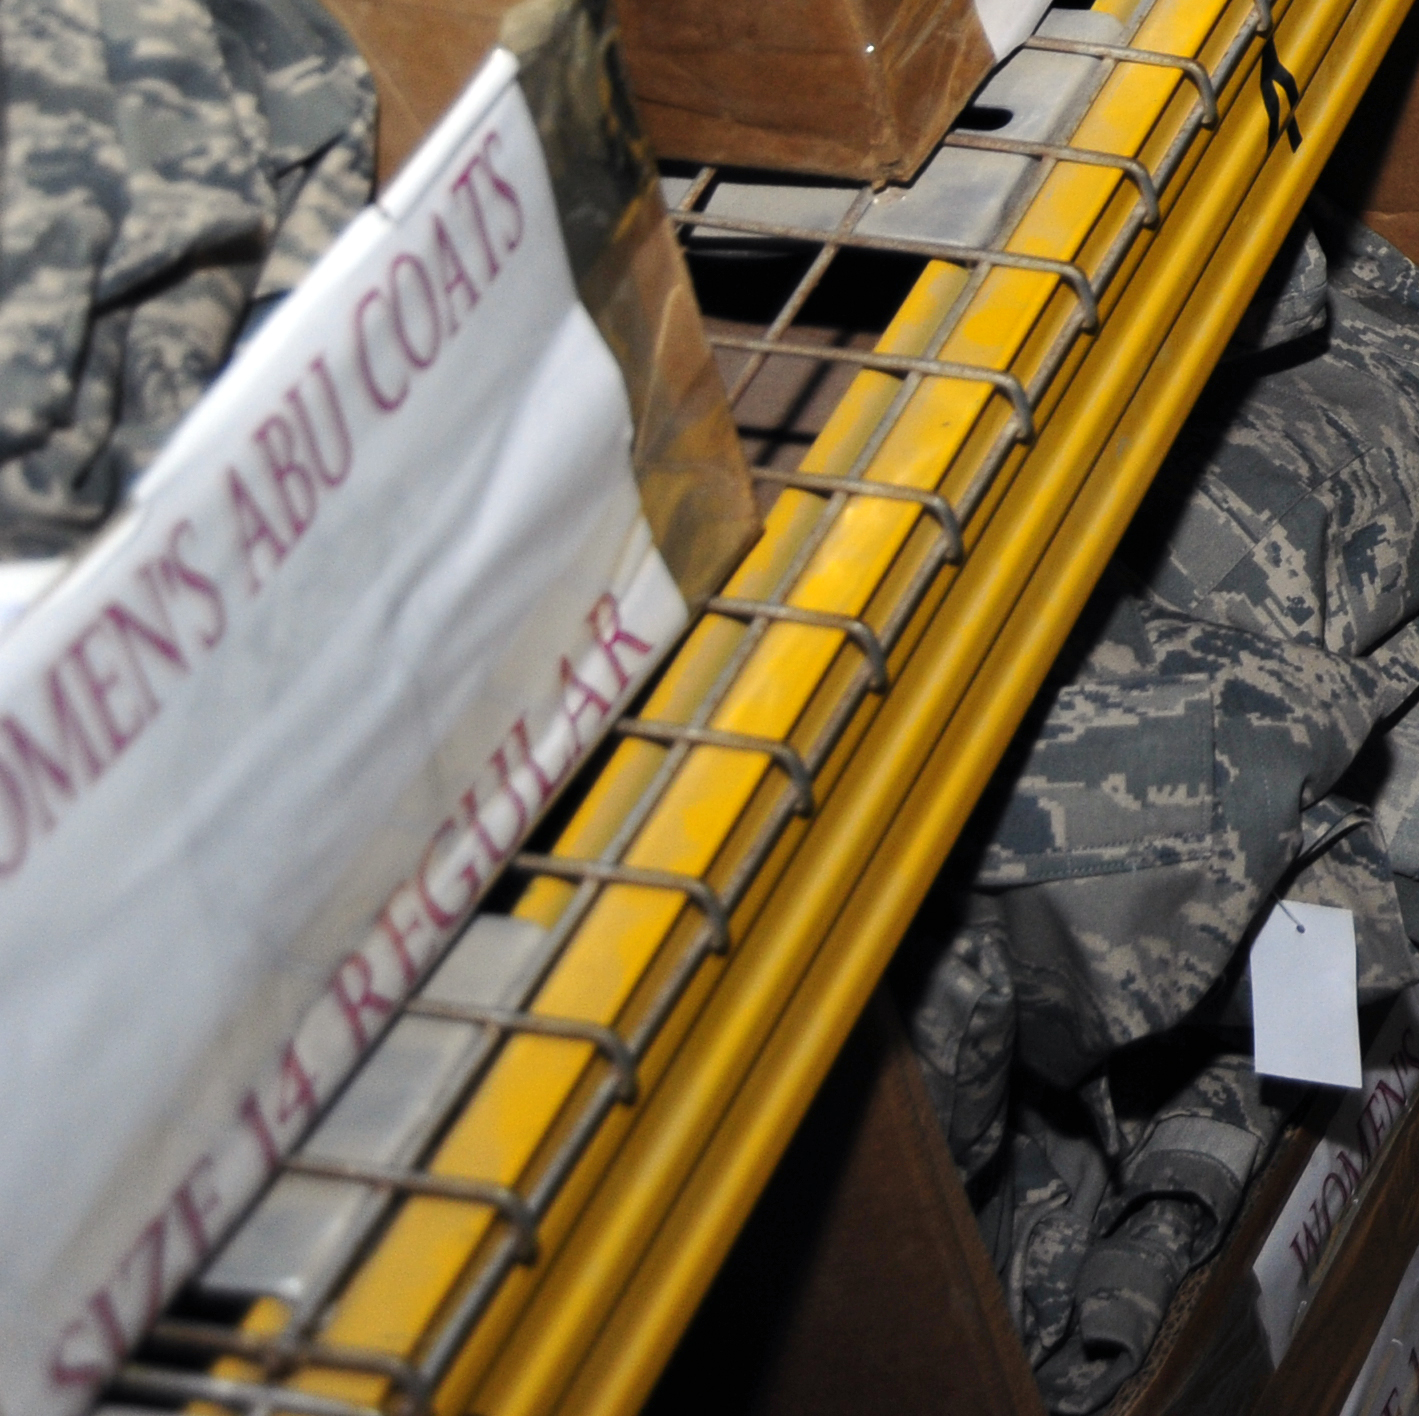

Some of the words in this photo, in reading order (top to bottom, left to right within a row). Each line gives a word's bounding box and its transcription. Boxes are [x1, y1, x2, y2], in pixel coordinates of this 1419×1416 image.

[224, 356, 355, 598] ABU
[352, 129, 526, 416] COATS
[235, 1038, 321, 1170] 14
[330, 590, 652, 1052] REGULAR
